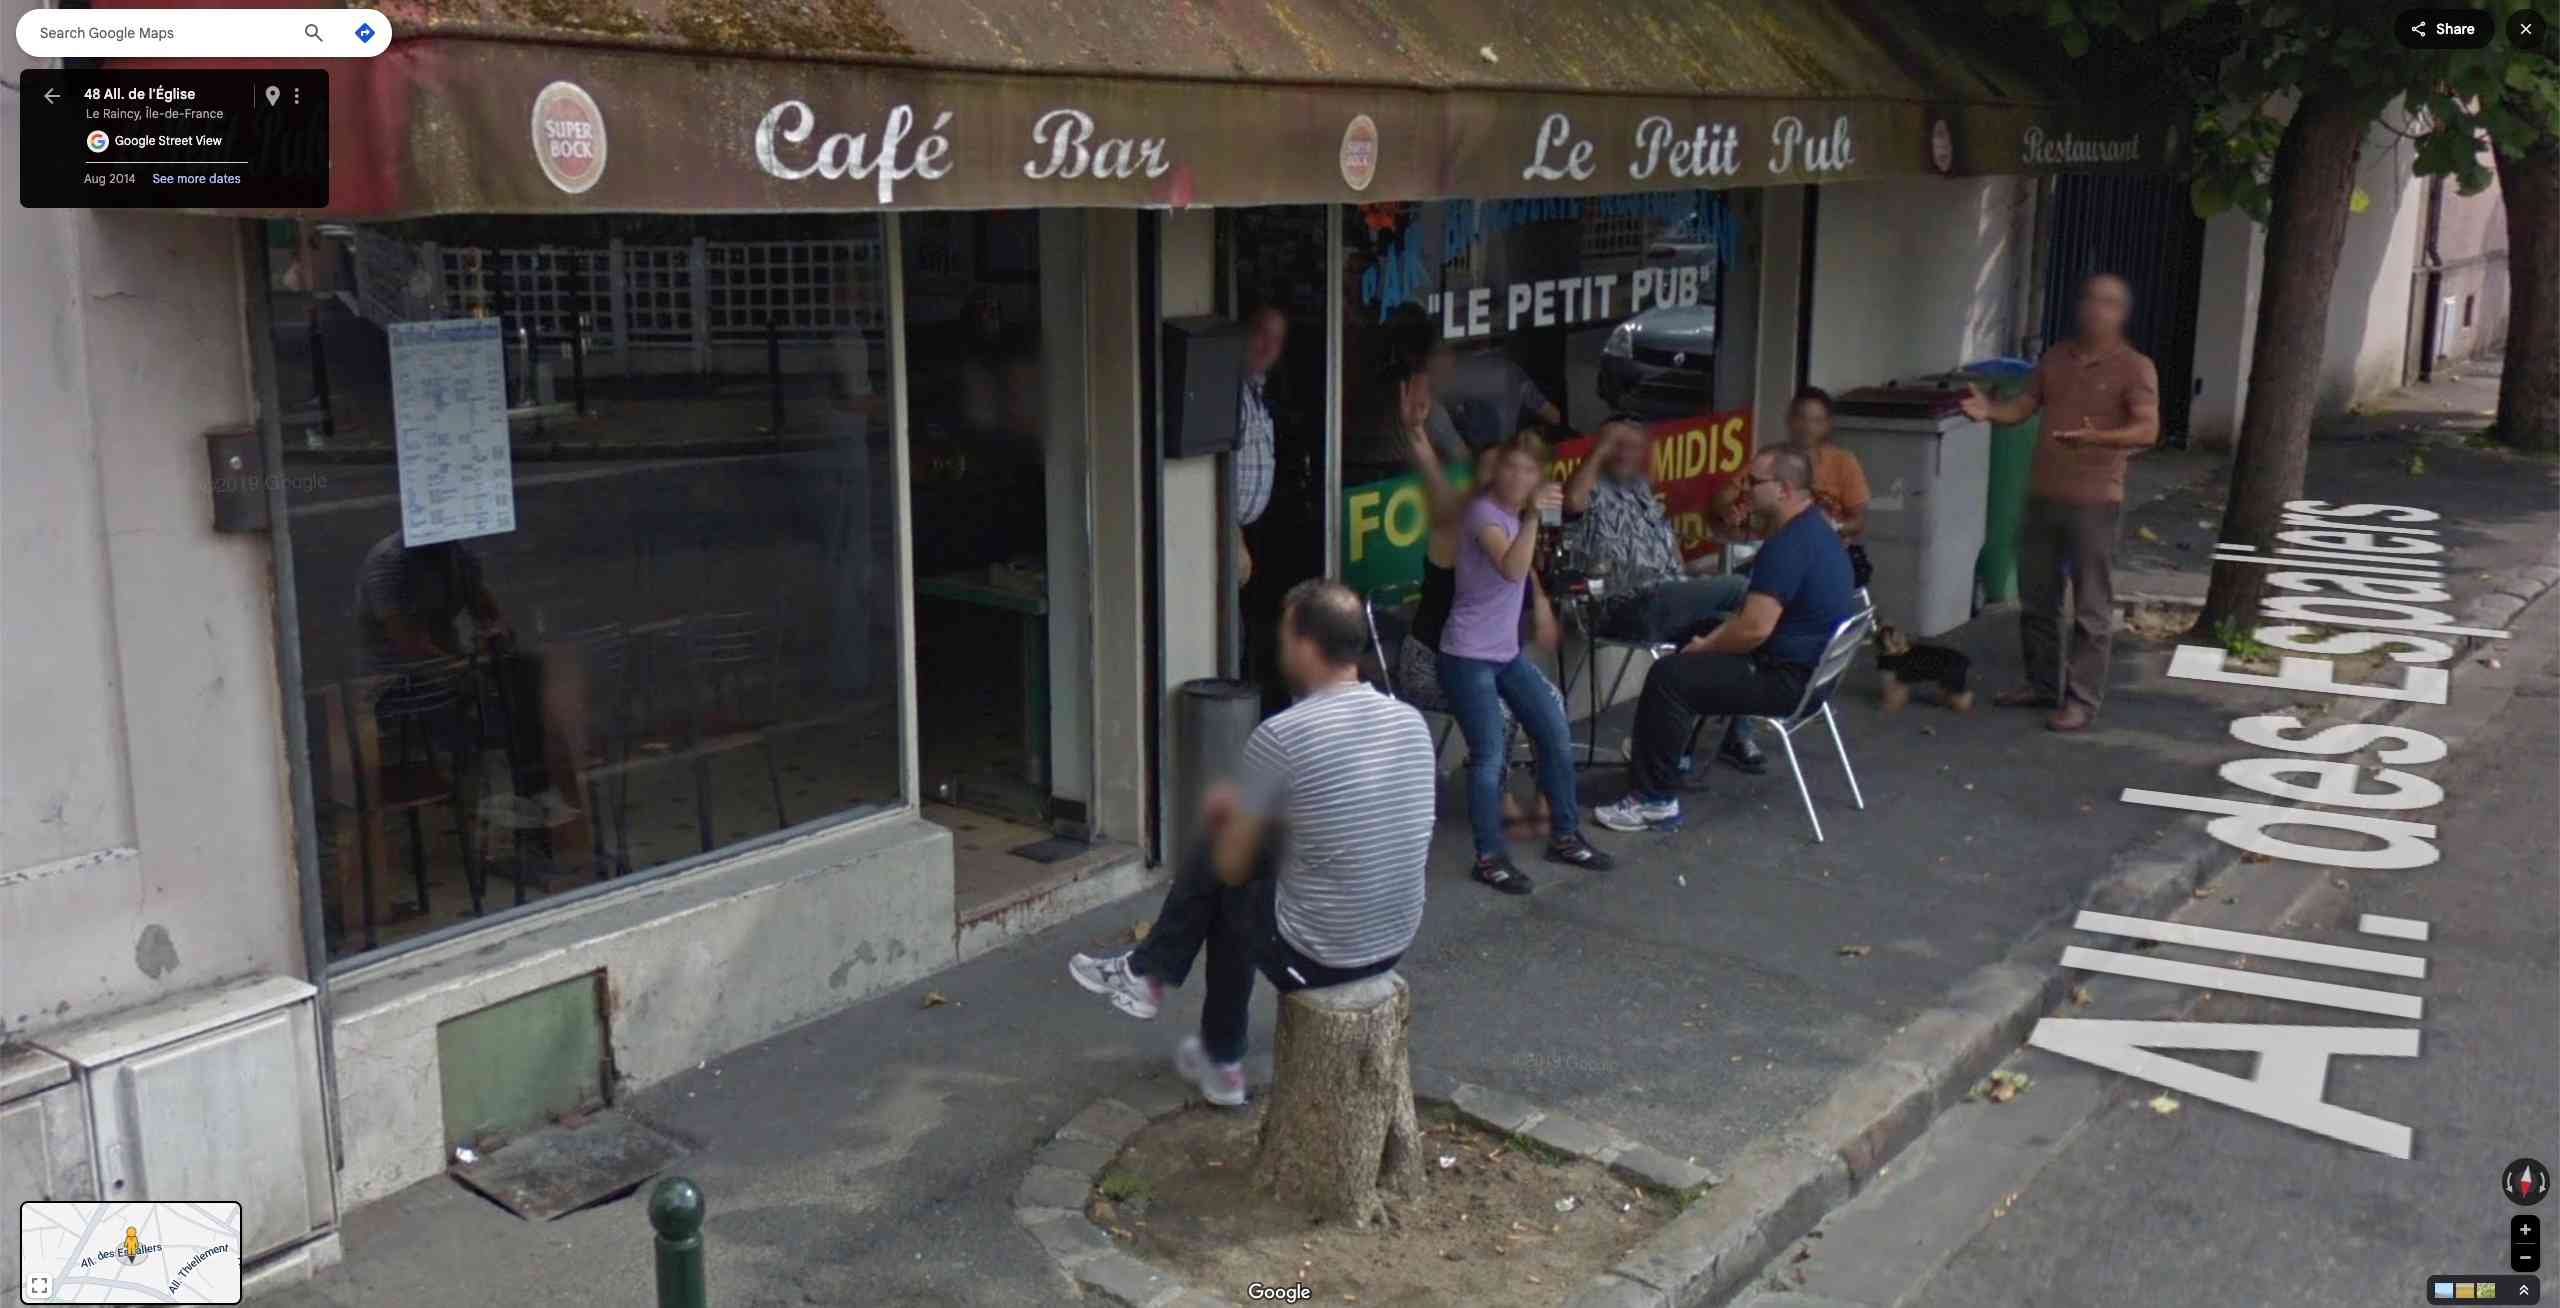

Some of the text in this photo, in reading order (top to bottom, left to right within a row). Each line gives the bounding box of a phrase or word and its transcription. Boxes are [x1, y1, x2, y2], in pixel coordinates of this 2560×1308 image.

[545, 120, 592, 139] SUPER
[551, 140, 592, 159] BOCK
[755, 101, 1169, 203] Café Bar
[1523, 113, 1855, 180] Le Petit Pub
[2022, 126, 2141, 163] Restaurant
[1428, 267, 1710, 340] "LE PETIT PUB"
[1654, 417, 1744, 480] MIDIS
